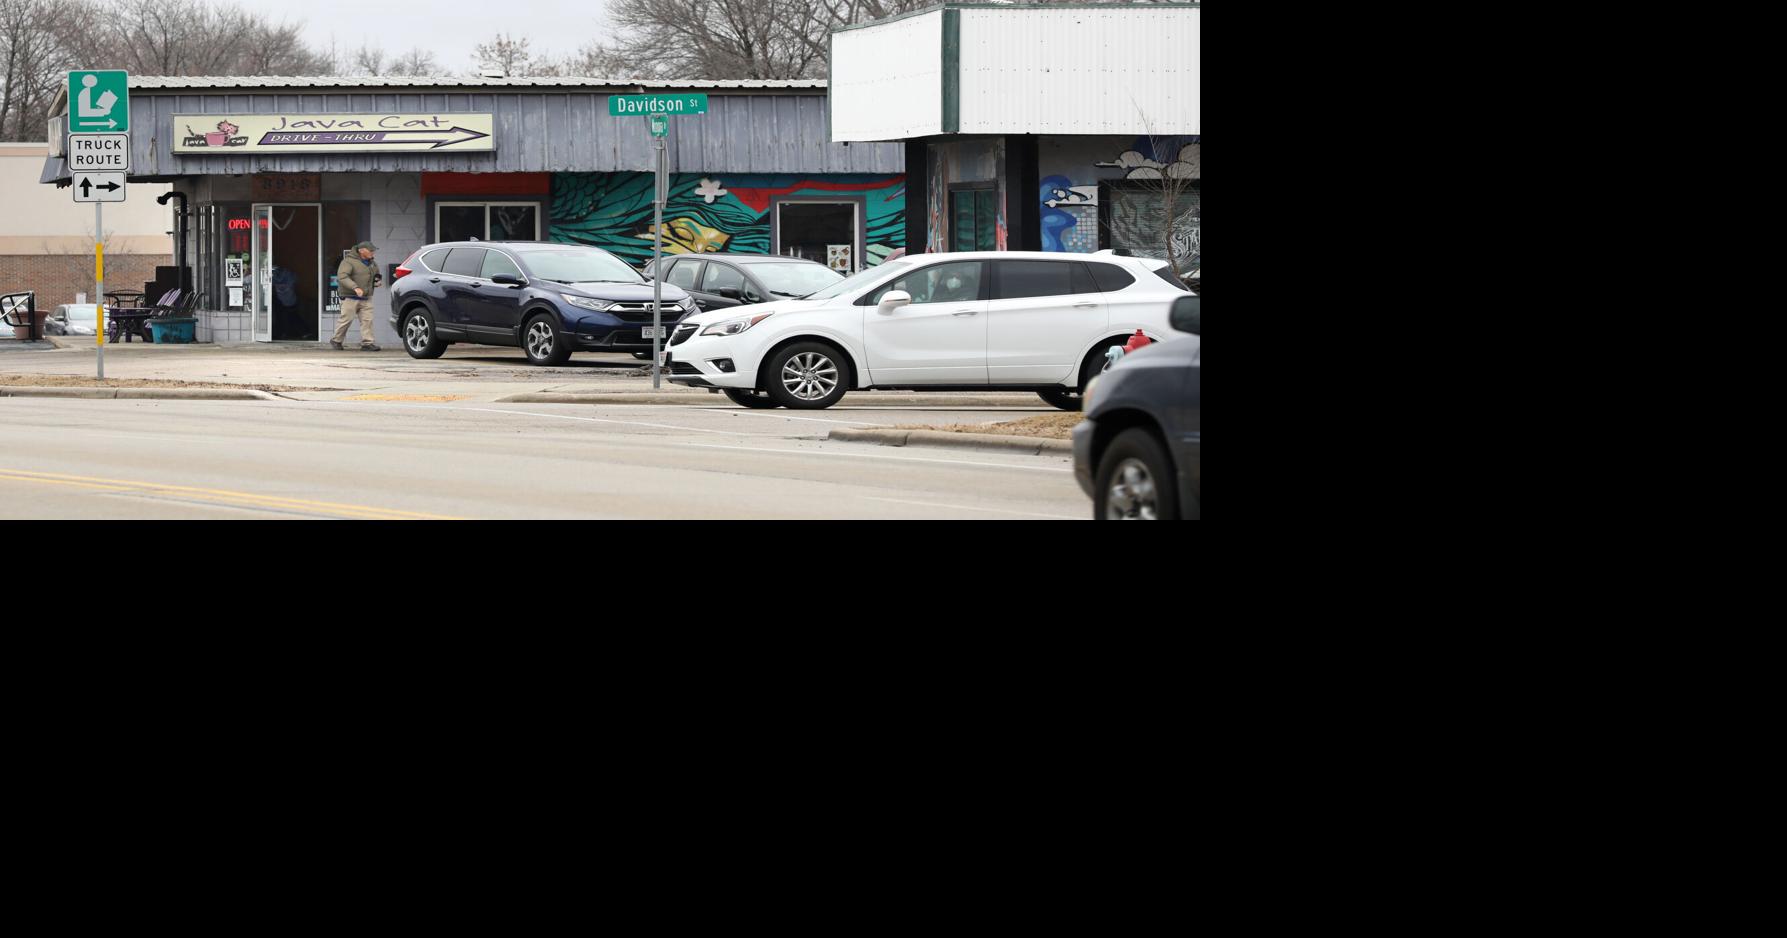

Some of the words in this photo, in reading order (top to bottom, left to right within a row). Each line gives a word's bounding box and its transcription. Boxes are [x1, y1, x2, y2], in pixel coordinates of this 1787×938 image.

[618, 97, 683, 112] Davidson
[689, 99, 698, 107] St
[272, 116, 364, 130] Java
[378, 115, 449, 128] Cat
[76, 140, 121, 150] TRUCK
[76, 155, 121, 165] ROUTE
[228, 219, 250, 229] OPEN
